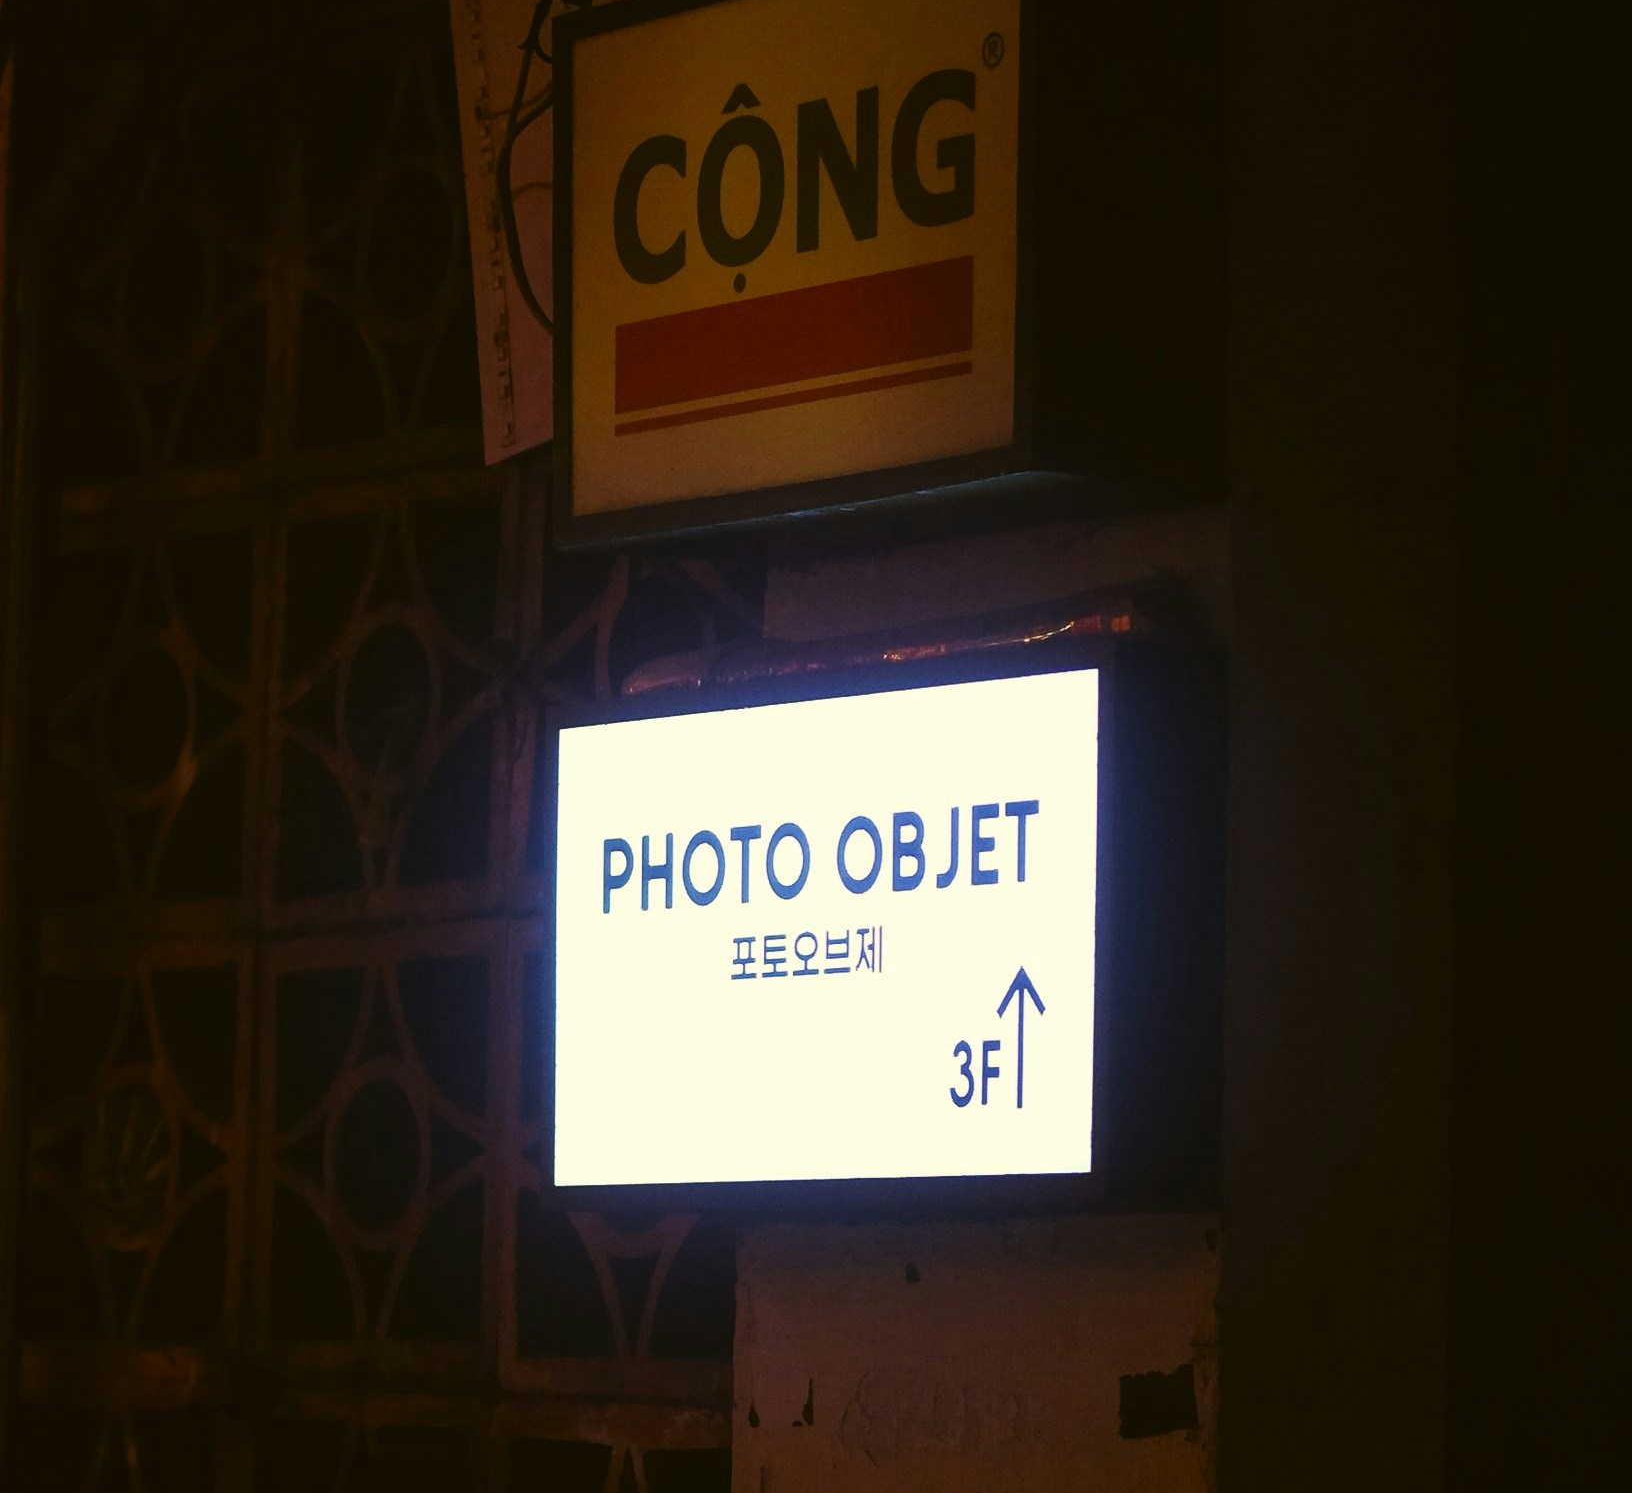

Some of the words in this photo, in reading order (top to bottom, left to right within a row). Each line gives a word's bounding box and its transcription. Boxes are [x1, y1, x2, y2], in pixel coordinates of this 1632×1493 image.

[613, 68, 976, 293] CỘNG
[602, 822, 811, 914] PHOTO
[836, 799, 1040, 895] OBJET
[730, 925, 883, 981] 포토오브제
[949, 1039, 1001, 1108] 3F
